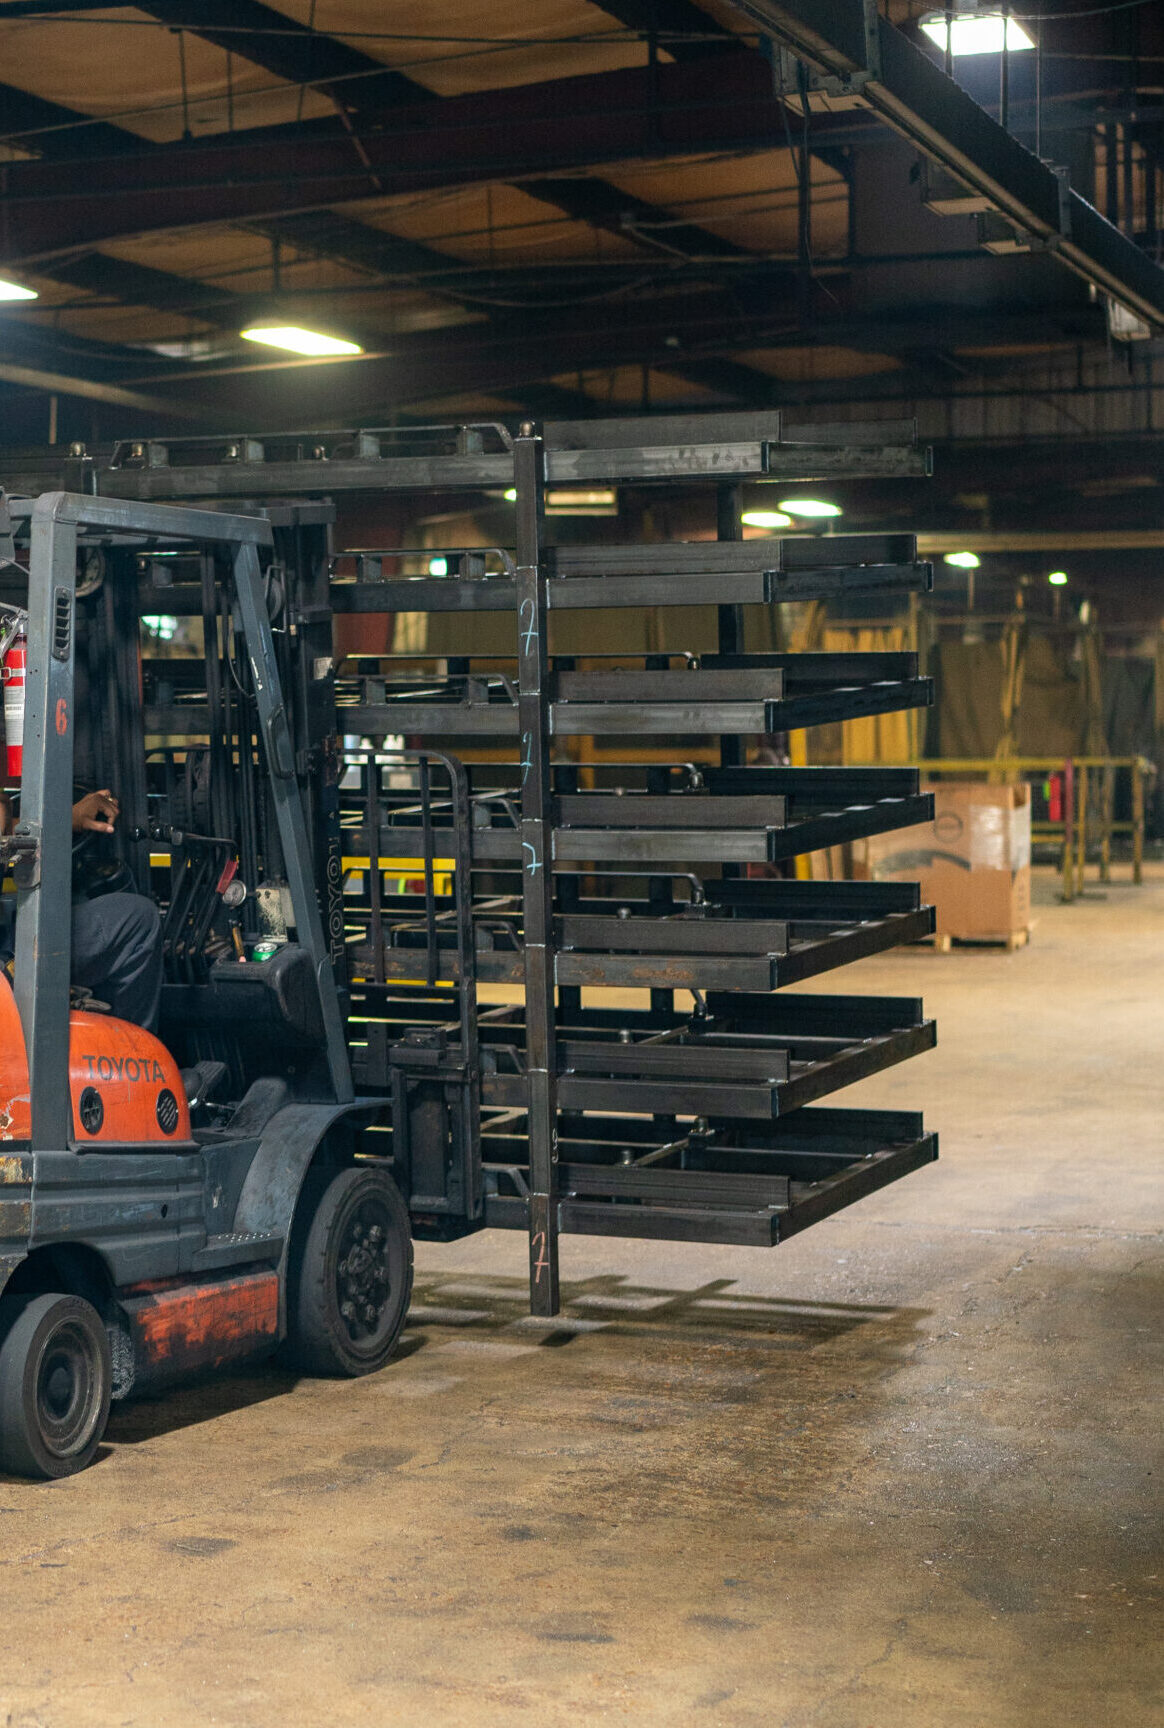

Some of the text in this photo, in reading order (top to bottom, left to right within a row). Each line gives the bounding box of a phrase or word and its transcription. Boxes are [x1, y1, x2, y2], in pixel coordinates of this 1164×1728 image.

[520, 598, 539, 657] 7
[55, 698, 68, 736] 6
[521, 841, 544, 876] 7
[82, 1054, 166, 1083] TOYOTA
[531, 1231, 550, 1284] 7
